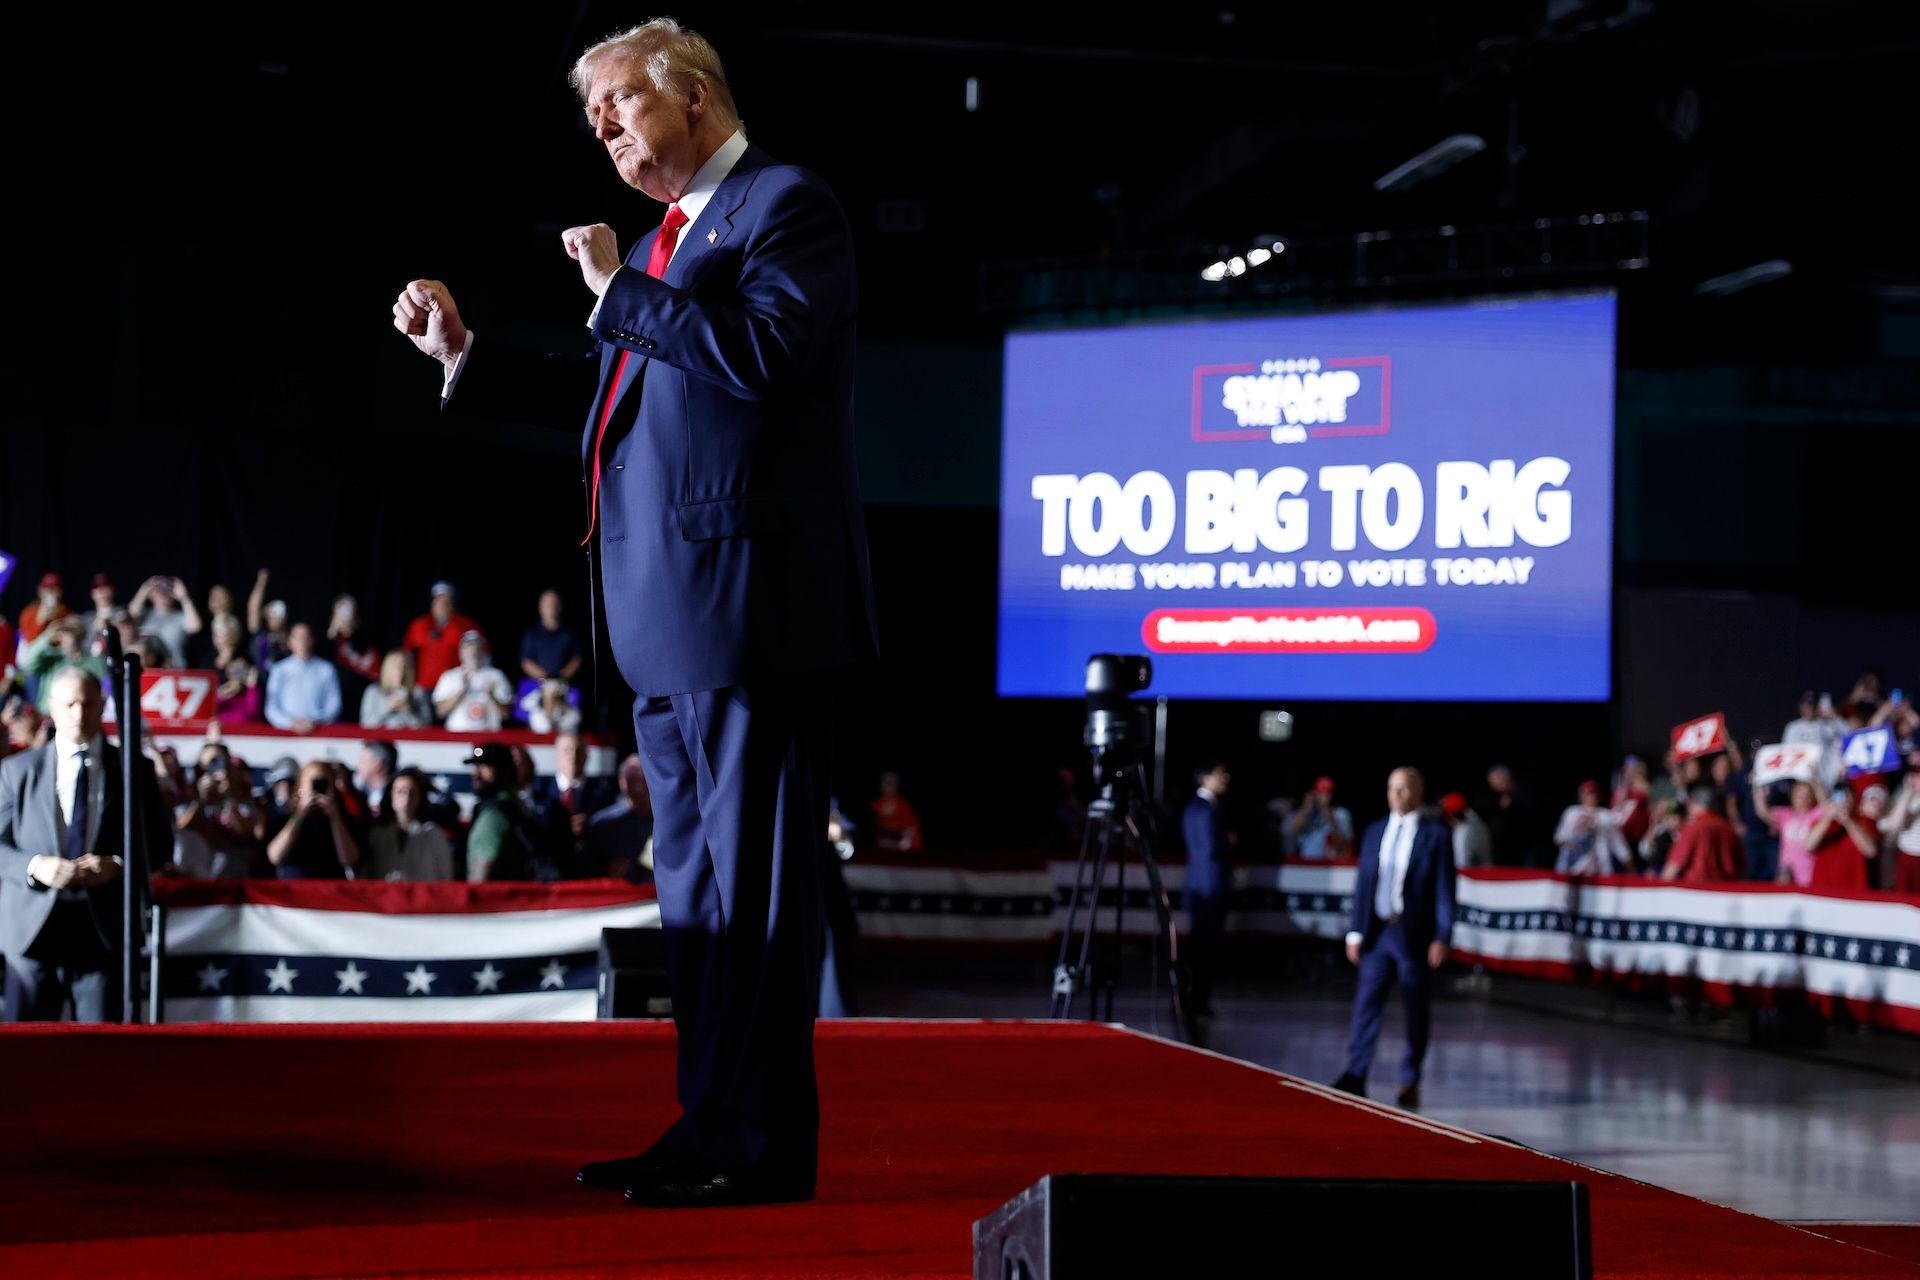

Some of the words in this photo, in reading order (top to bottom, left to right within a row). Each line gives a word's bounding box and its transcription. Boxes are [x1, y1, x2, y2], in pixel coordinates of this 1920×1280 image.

[1032, 470, 1176, 557] TOO
[1185, 466, 1309, 553] BIG
[1319, 462, 1424, 551] TO
[1435, 456, 1572, 548] RIG
[1060, 563, 1136, 590] MAKE
[1140, 562, 1216, 590] YOUR
[1220, 561, 1296, 589] PLAN
[1301, 560, 1343, 588] TO
[1347, 559, 1427, 587] VOTE
[1431, 556, 1535, 586] TODAY
[141, 676, 210, 719] 47
[1675, 717, 1720, 754] 47
[1844, 729, 1890, 770] 47
[1764, 753, 1806, 769] 47
